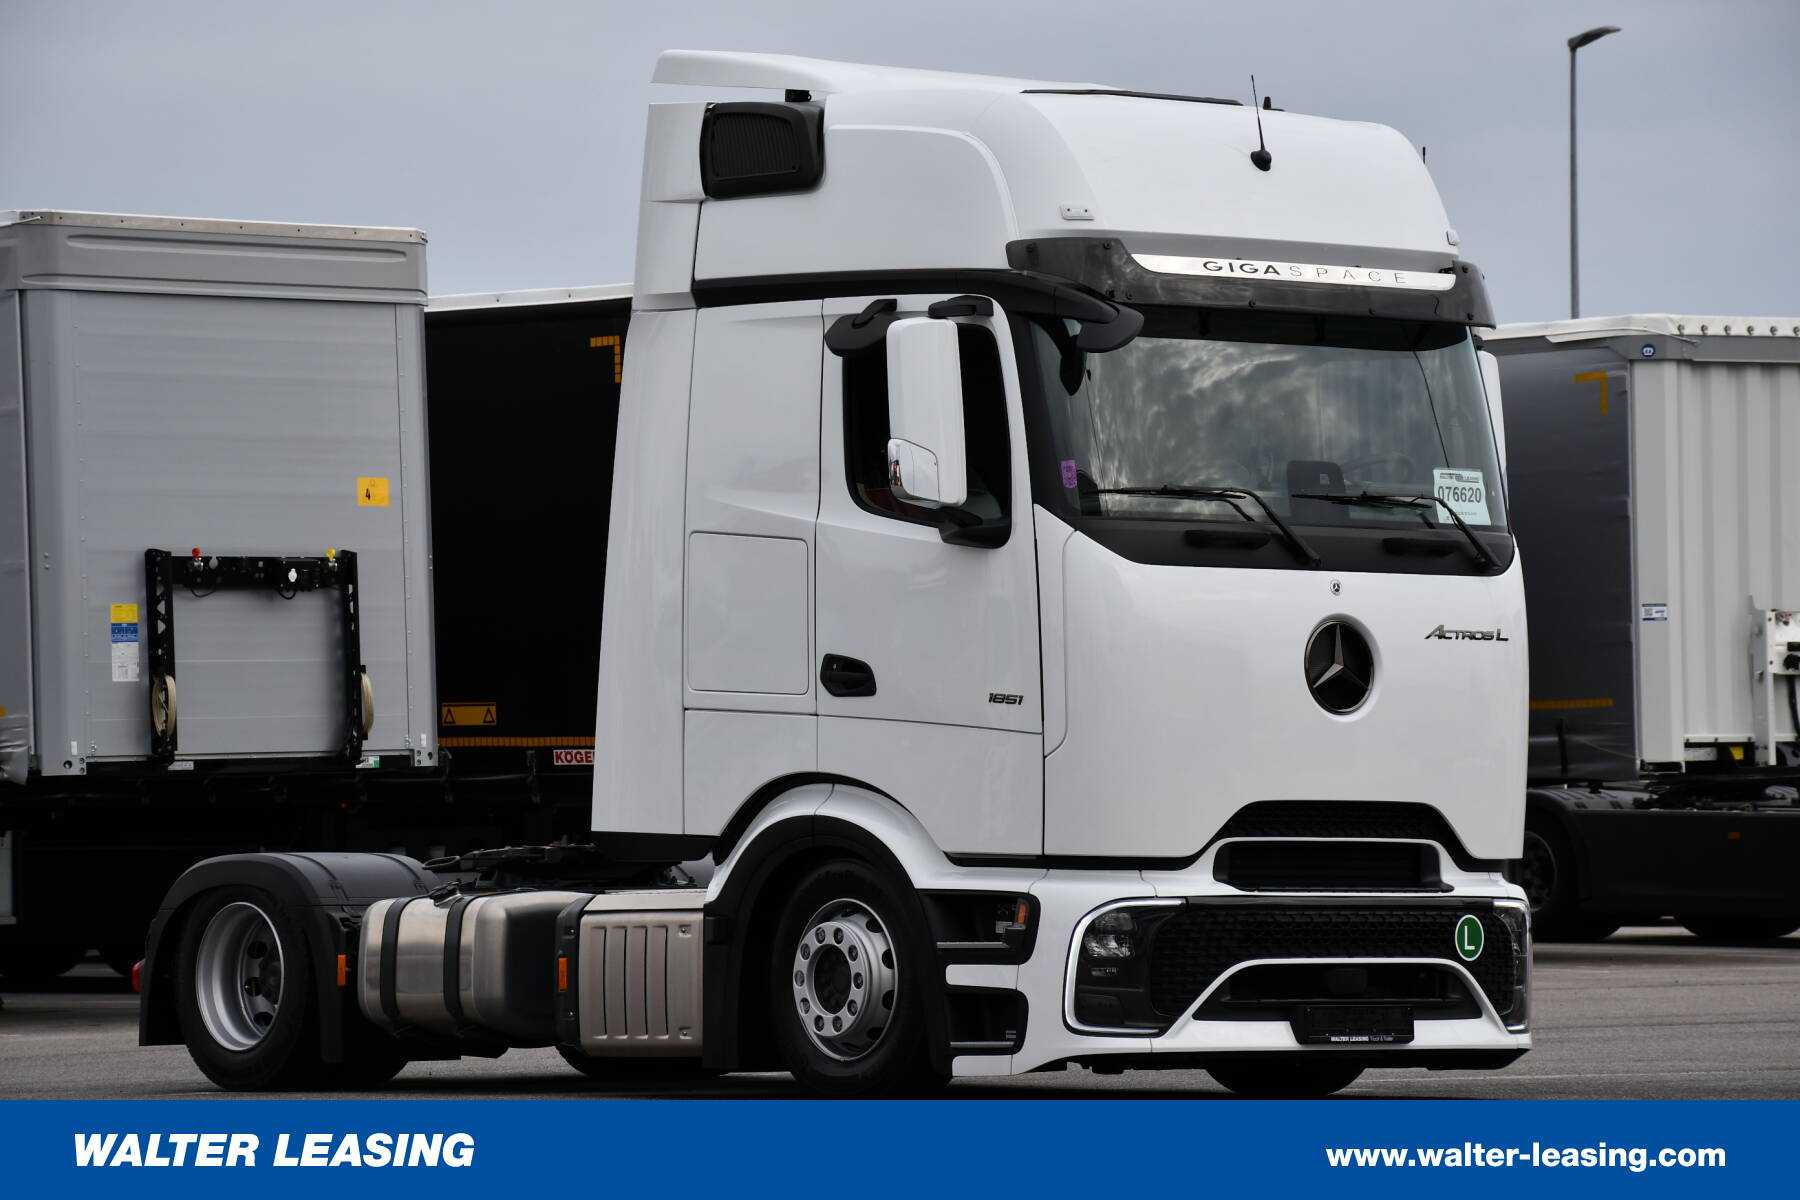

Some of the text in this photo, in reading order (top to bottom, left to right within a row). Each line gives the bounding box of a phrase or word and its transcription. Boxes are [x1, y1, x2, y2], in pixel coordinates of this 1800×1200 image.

[1438, 485, 1482, 504] 076620
[988, 693, 1024, 705] 1851
[1464, 925, 1476, 951] L
